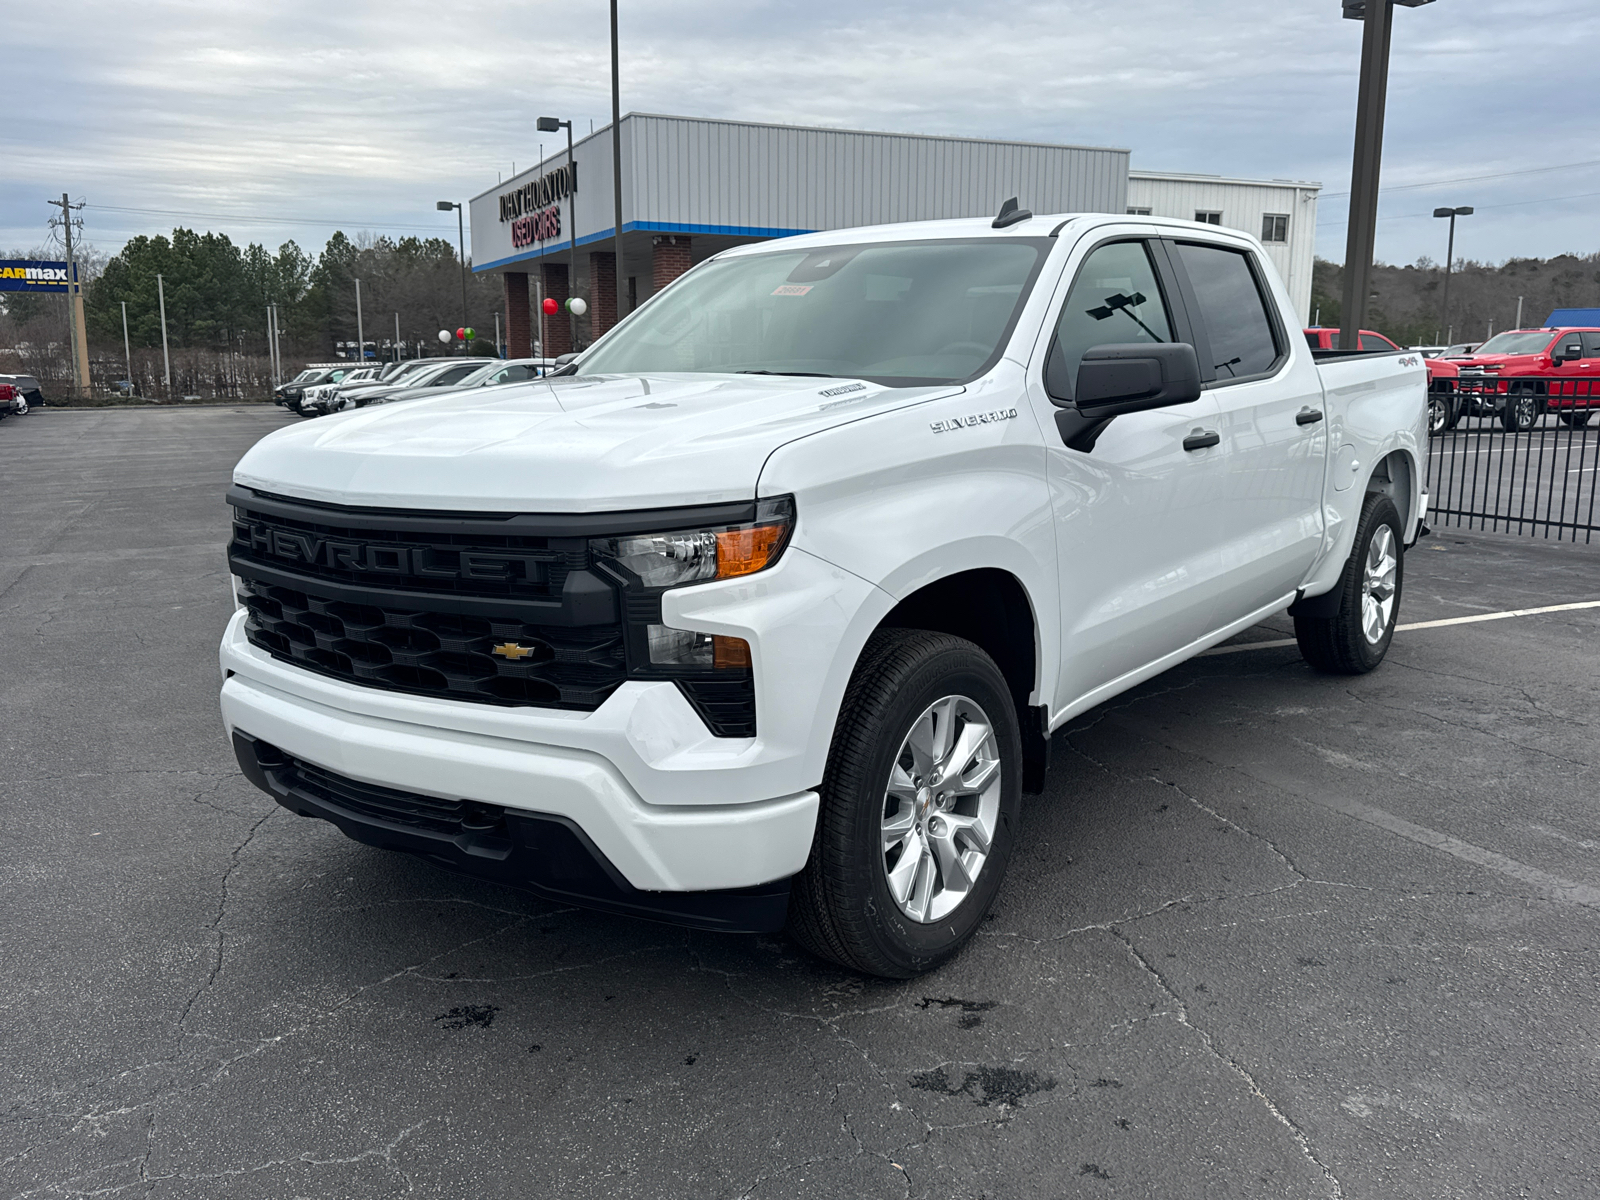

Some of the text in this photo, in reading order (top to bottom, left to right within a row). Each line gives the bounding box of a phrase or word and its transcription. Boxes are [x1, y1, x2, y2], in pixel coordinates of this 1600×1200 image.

[499, 189, 521, 222] JOHN
[511, 205, 561, 248] USED CARS
[0, 267, 67, 280] ARmax
[930, 408, 1018, 434] SILVERADO
[232, 519, 567, 584] CHEVROLET
[906, 655, 970, 699] BRIDGESTONE
